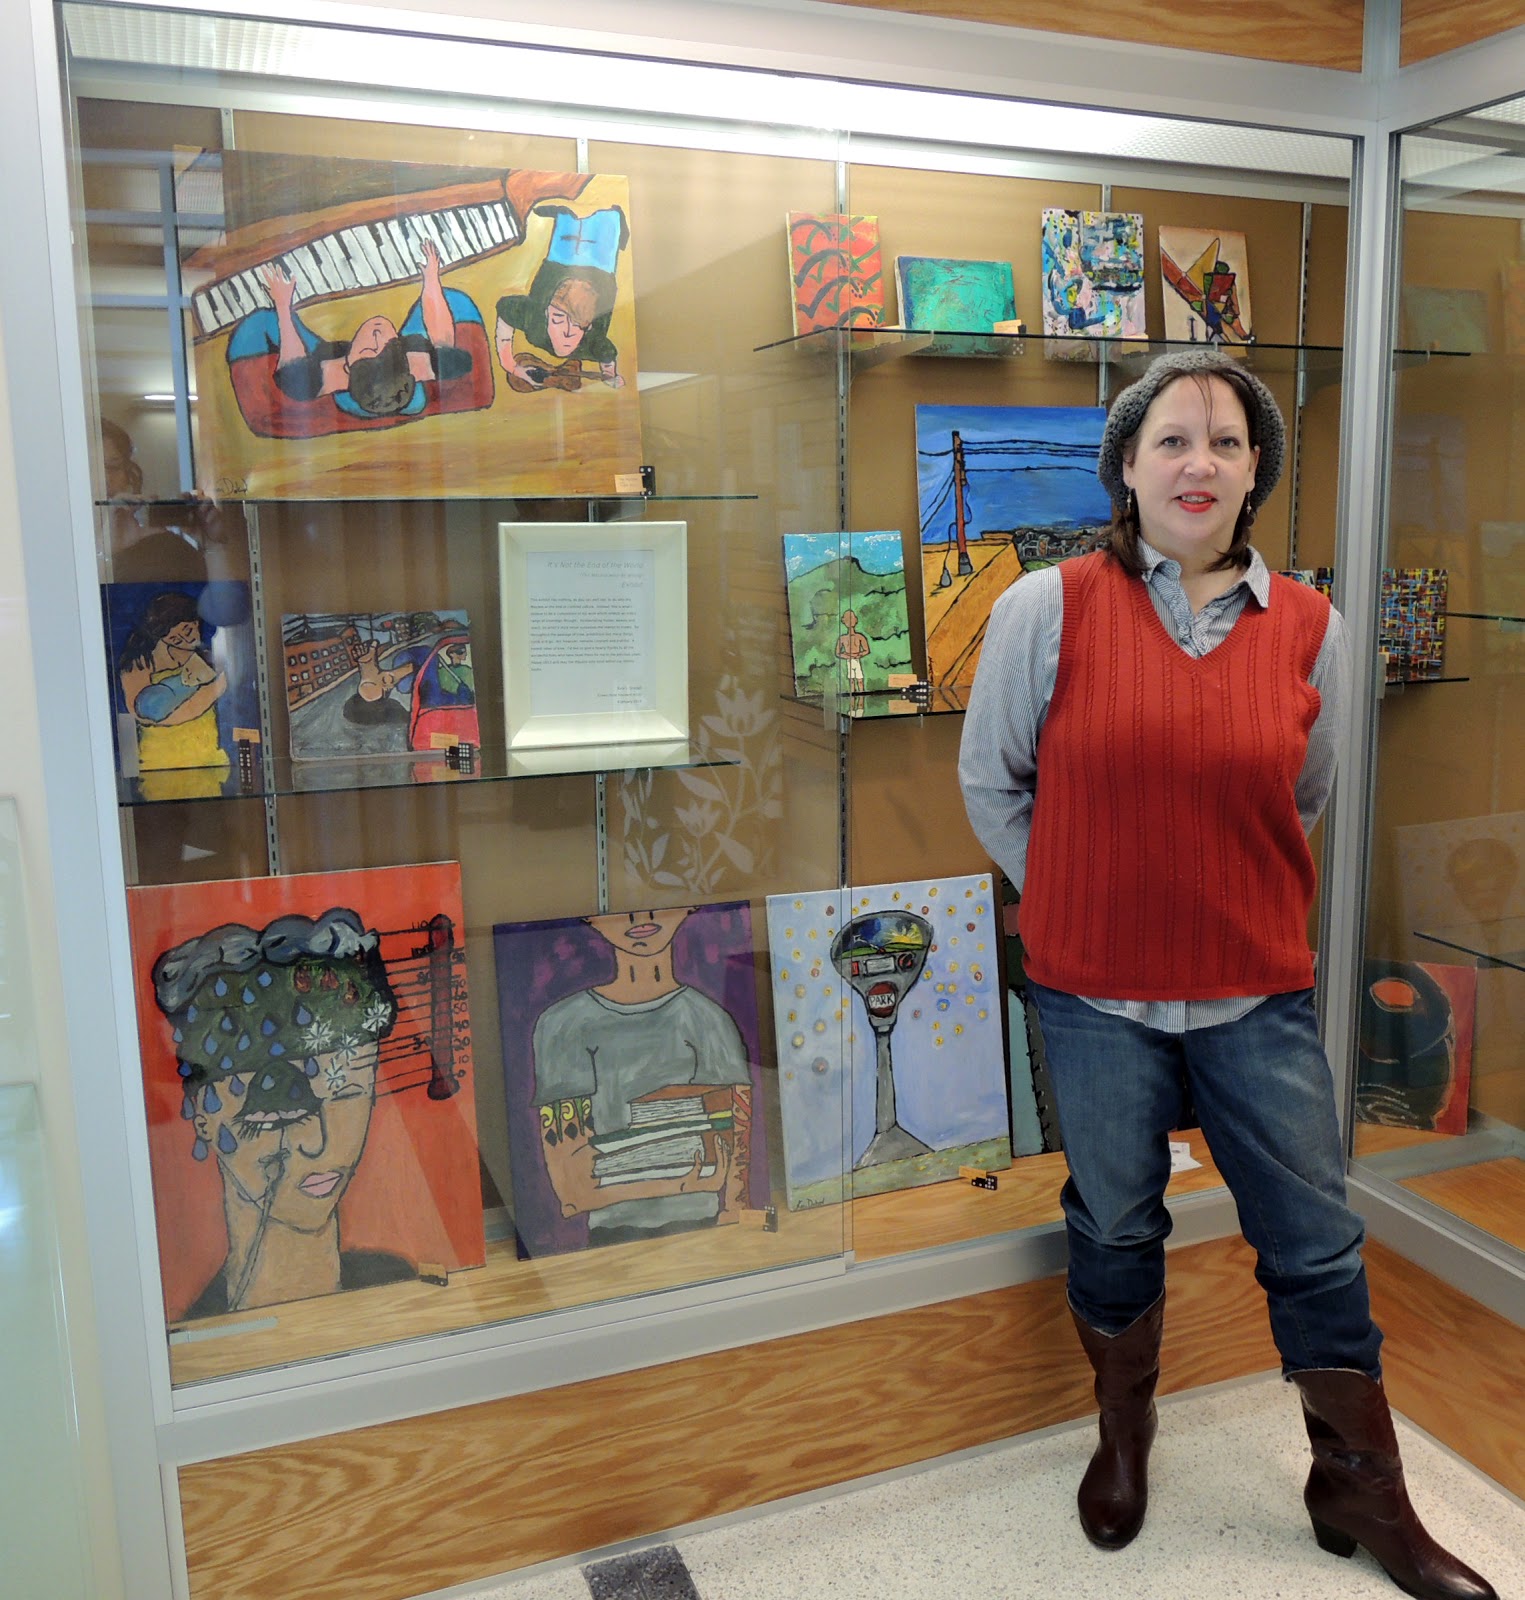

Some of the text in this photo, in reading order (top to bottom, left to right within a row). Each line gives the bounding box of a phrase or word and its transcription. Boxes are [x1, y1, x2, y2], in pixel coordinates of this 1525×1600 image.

[560, 561, 572, 569] Not
[573, 561, 586, 569] the
[587, 561, 601, 569] End
[869, 993, 894, 1006] PARK
